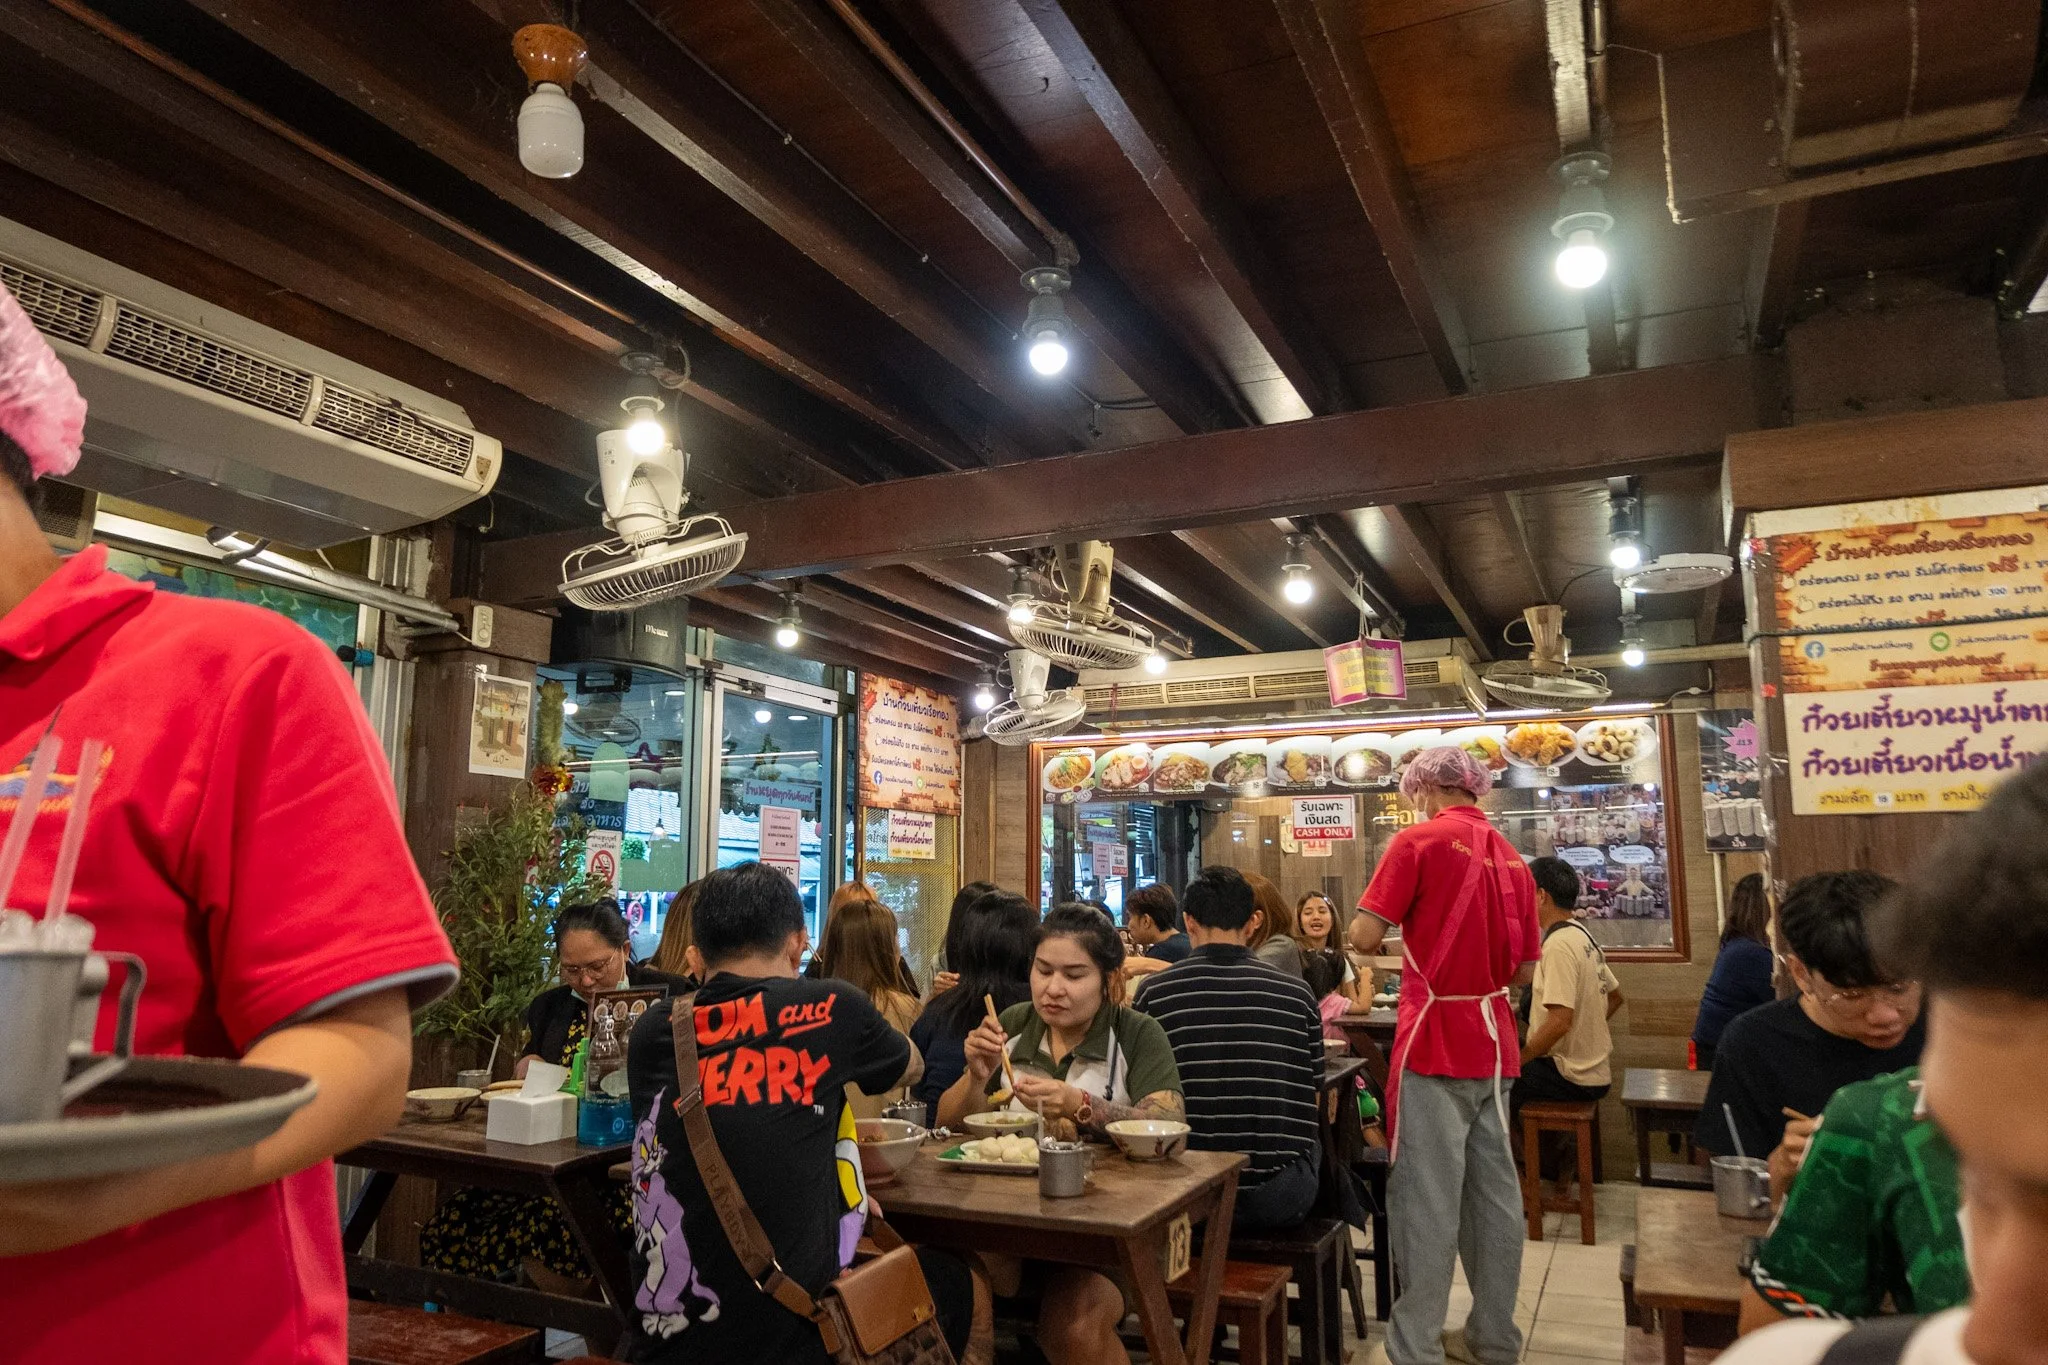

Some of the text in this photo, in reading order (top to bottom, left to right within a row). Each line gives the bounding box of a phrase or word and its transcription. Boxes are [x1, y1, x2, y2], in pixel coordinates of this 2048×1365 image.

[1300, 801, 1344, 812] รับเฉพาะ
[1304, 813, 1341, 825] เงินสด
[1295, 827, 1352, 837] CASH ONLY
[778, 993, 838, 1028] and
[813, 1105, 825, 1115] TM
